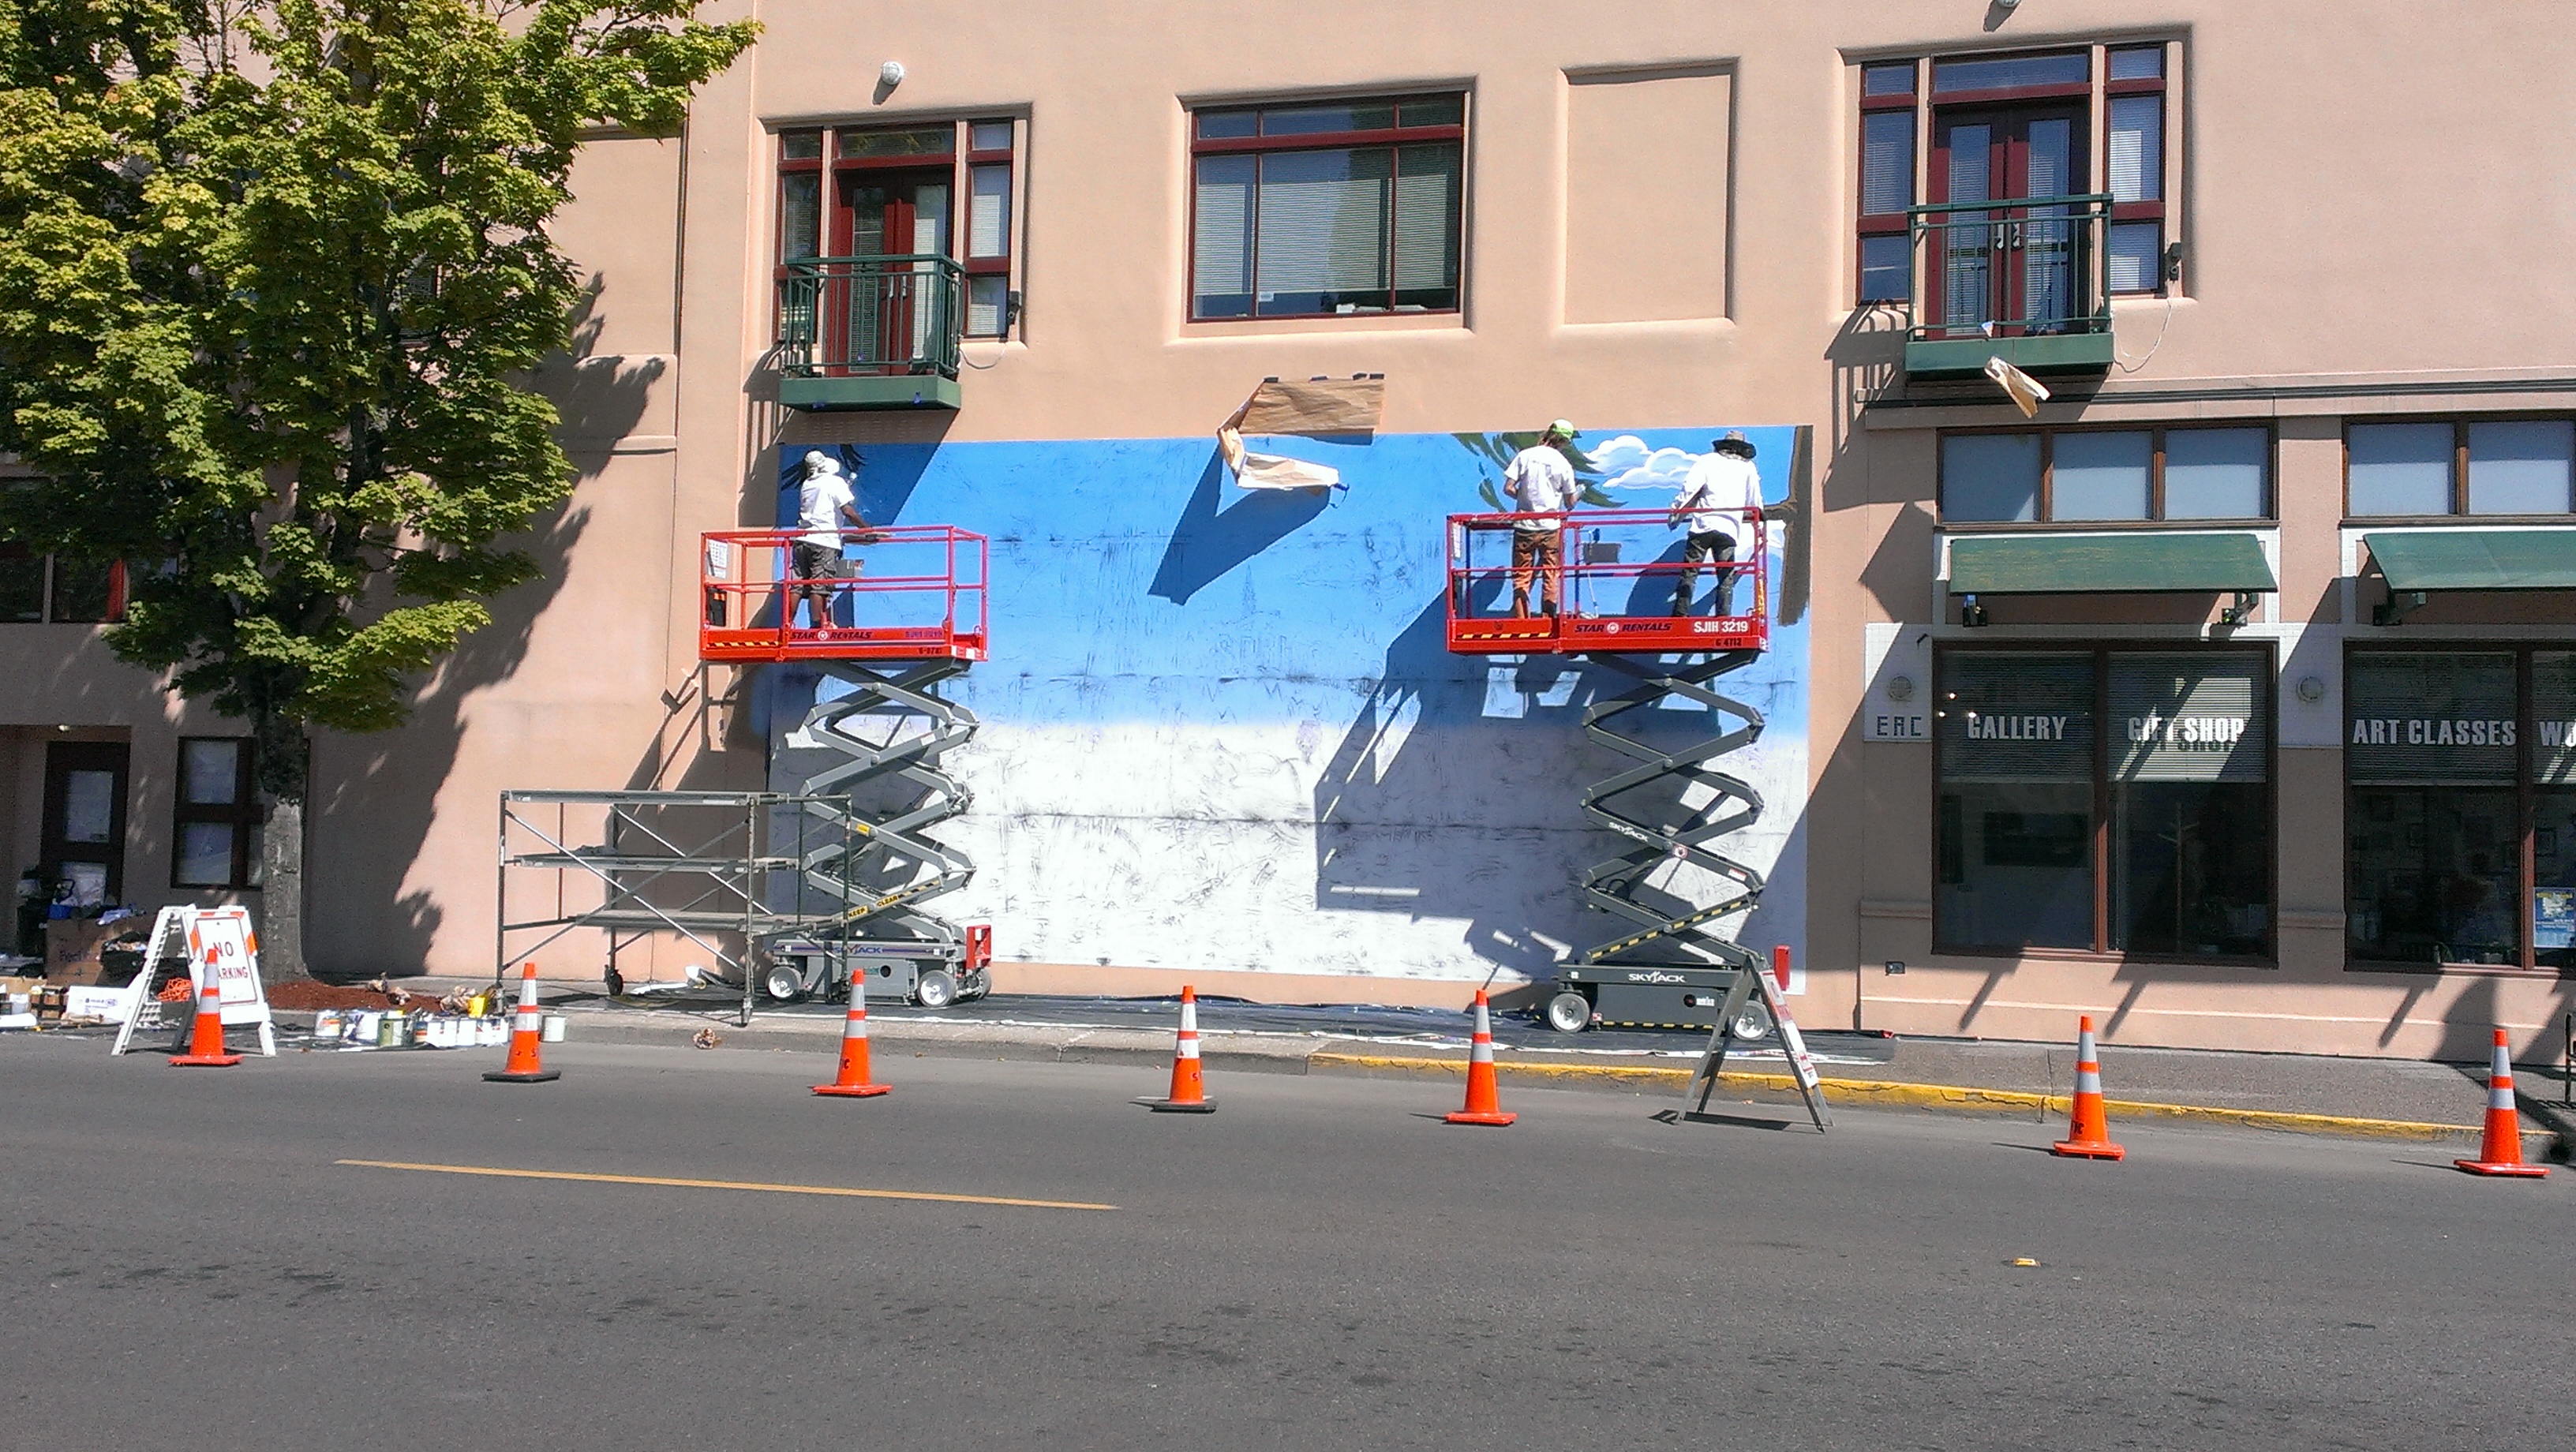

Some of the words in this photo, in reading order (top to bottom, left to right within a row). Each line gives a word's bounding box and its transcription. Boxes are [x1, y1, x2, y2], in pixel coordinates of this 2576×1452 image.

[1622, 623, 1672, 631] RENTALS
[1721, 620, 1748, 632] 3219
[789, 631, 817, 640] STAR
[1877, 716, 1922, 736] EAC
[1968, 715, 2066, 739] GALLERY
[2128, 717, 2176, 741] GIFT
[2184, 717, 2244, 743] SHOP
[2353, 720, 2400, 744] ART
[2409, 720, 2517, 746] CLASSES
[1608, 821, 1649, 842] SKYJACK
[848, 908, 865, 917] KEEP
[877, 896, 898, 907] CLEAR
[213, 941, 234, 957] NO
[833, 944, 882, 955] SYJACK
[1628, 971, 1687, 983] SKYJACK
